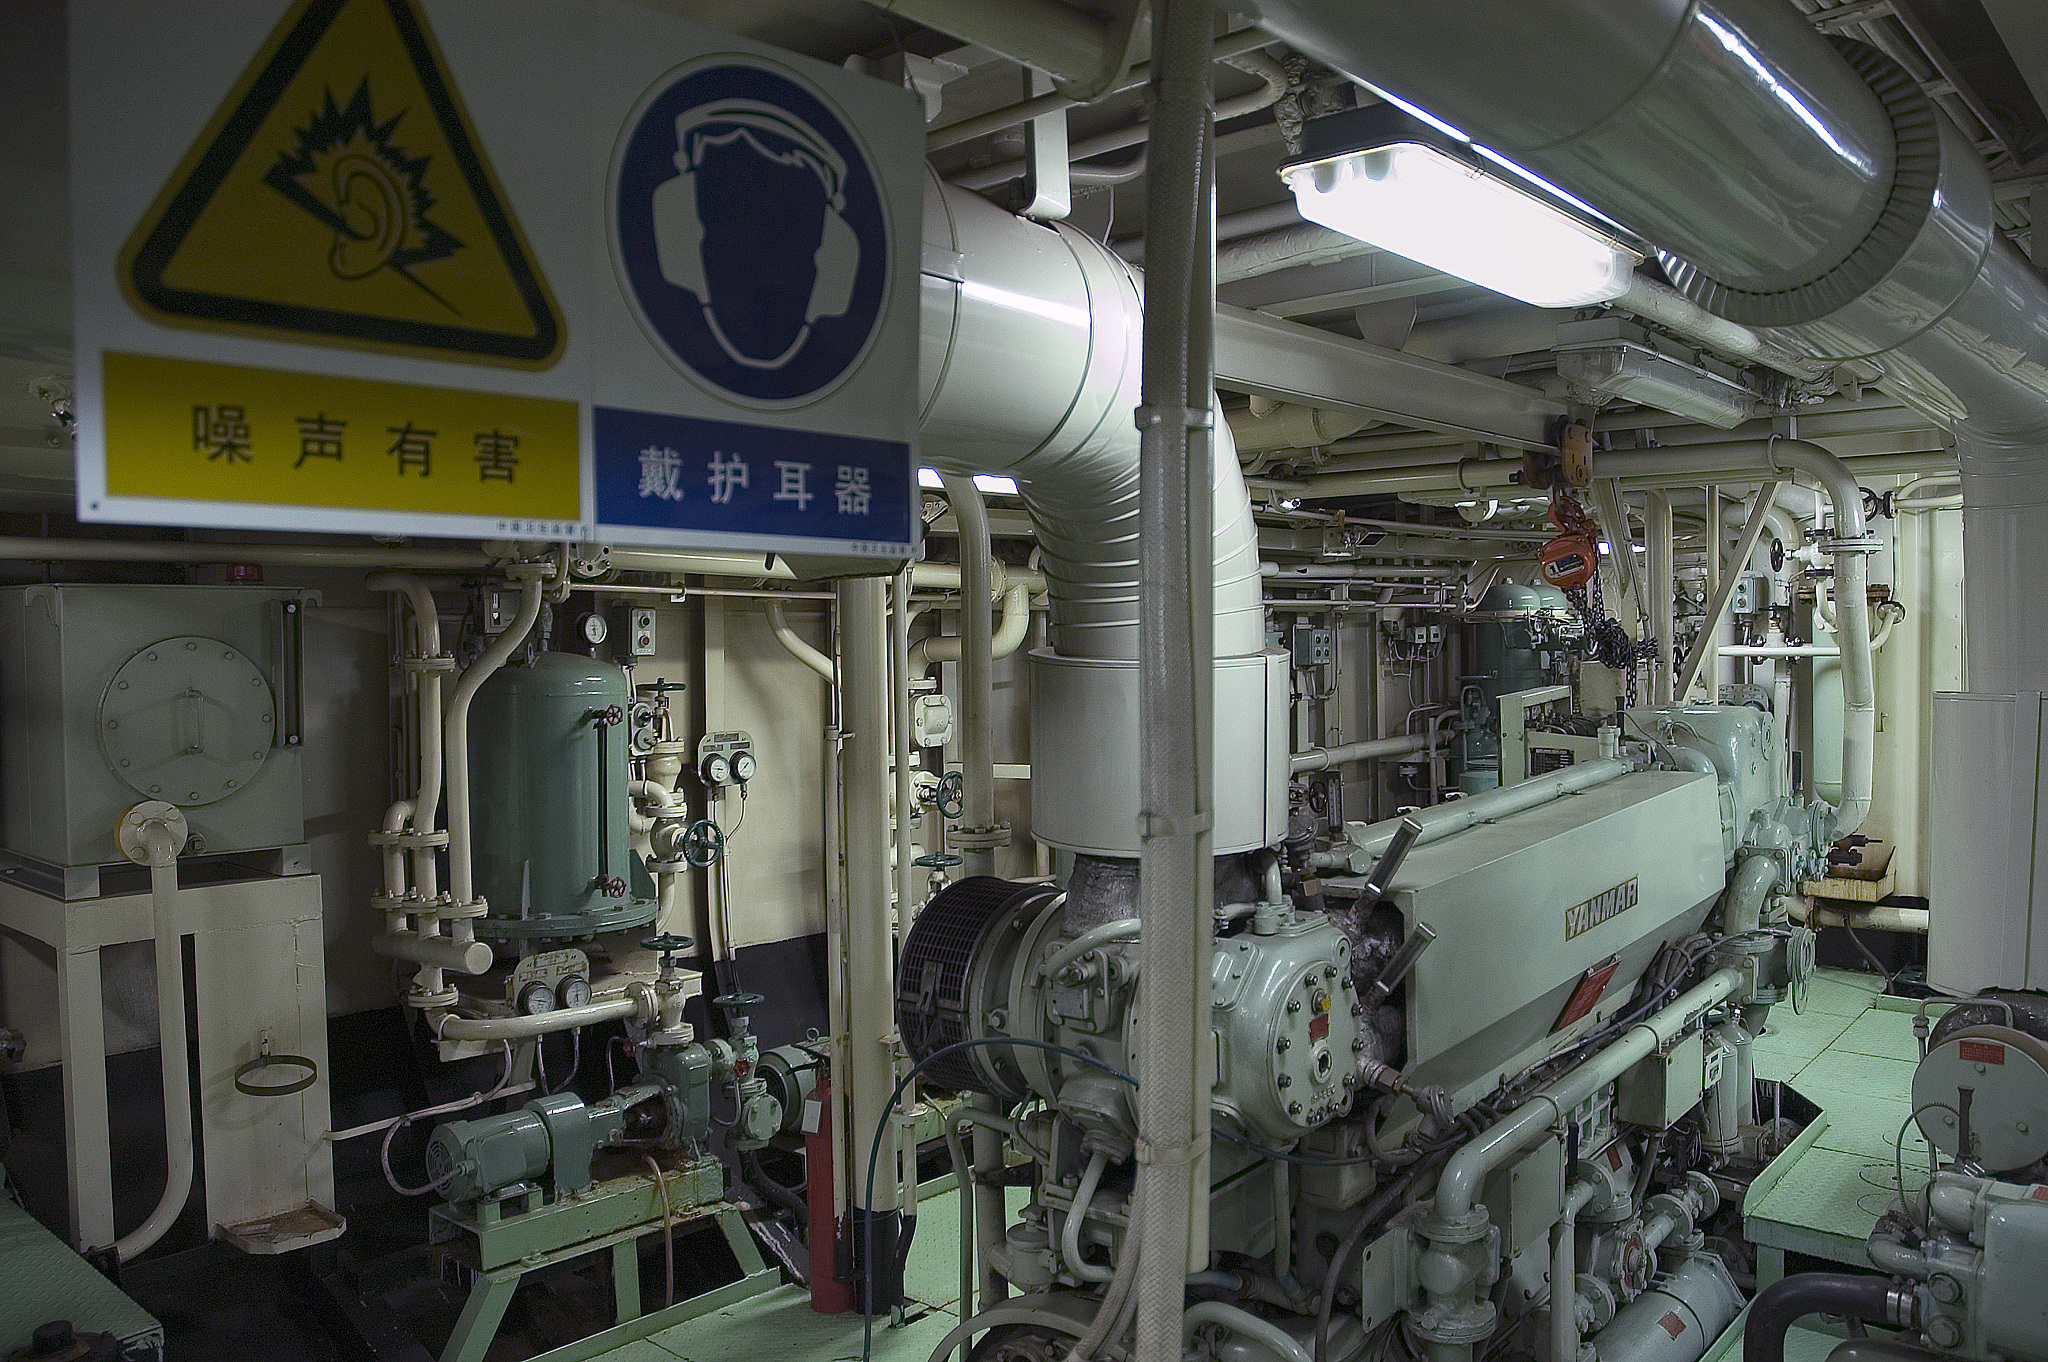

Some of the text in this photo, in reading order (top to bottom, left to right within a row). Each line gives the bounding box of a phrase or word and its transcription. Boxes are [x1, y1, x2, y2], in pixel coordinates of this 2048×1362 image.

[192, 403, 519, 483] 噪声有害
[637, 445, 872, 516] 戴护耳器
[1566, 877, 1638, 939] YANMAR
